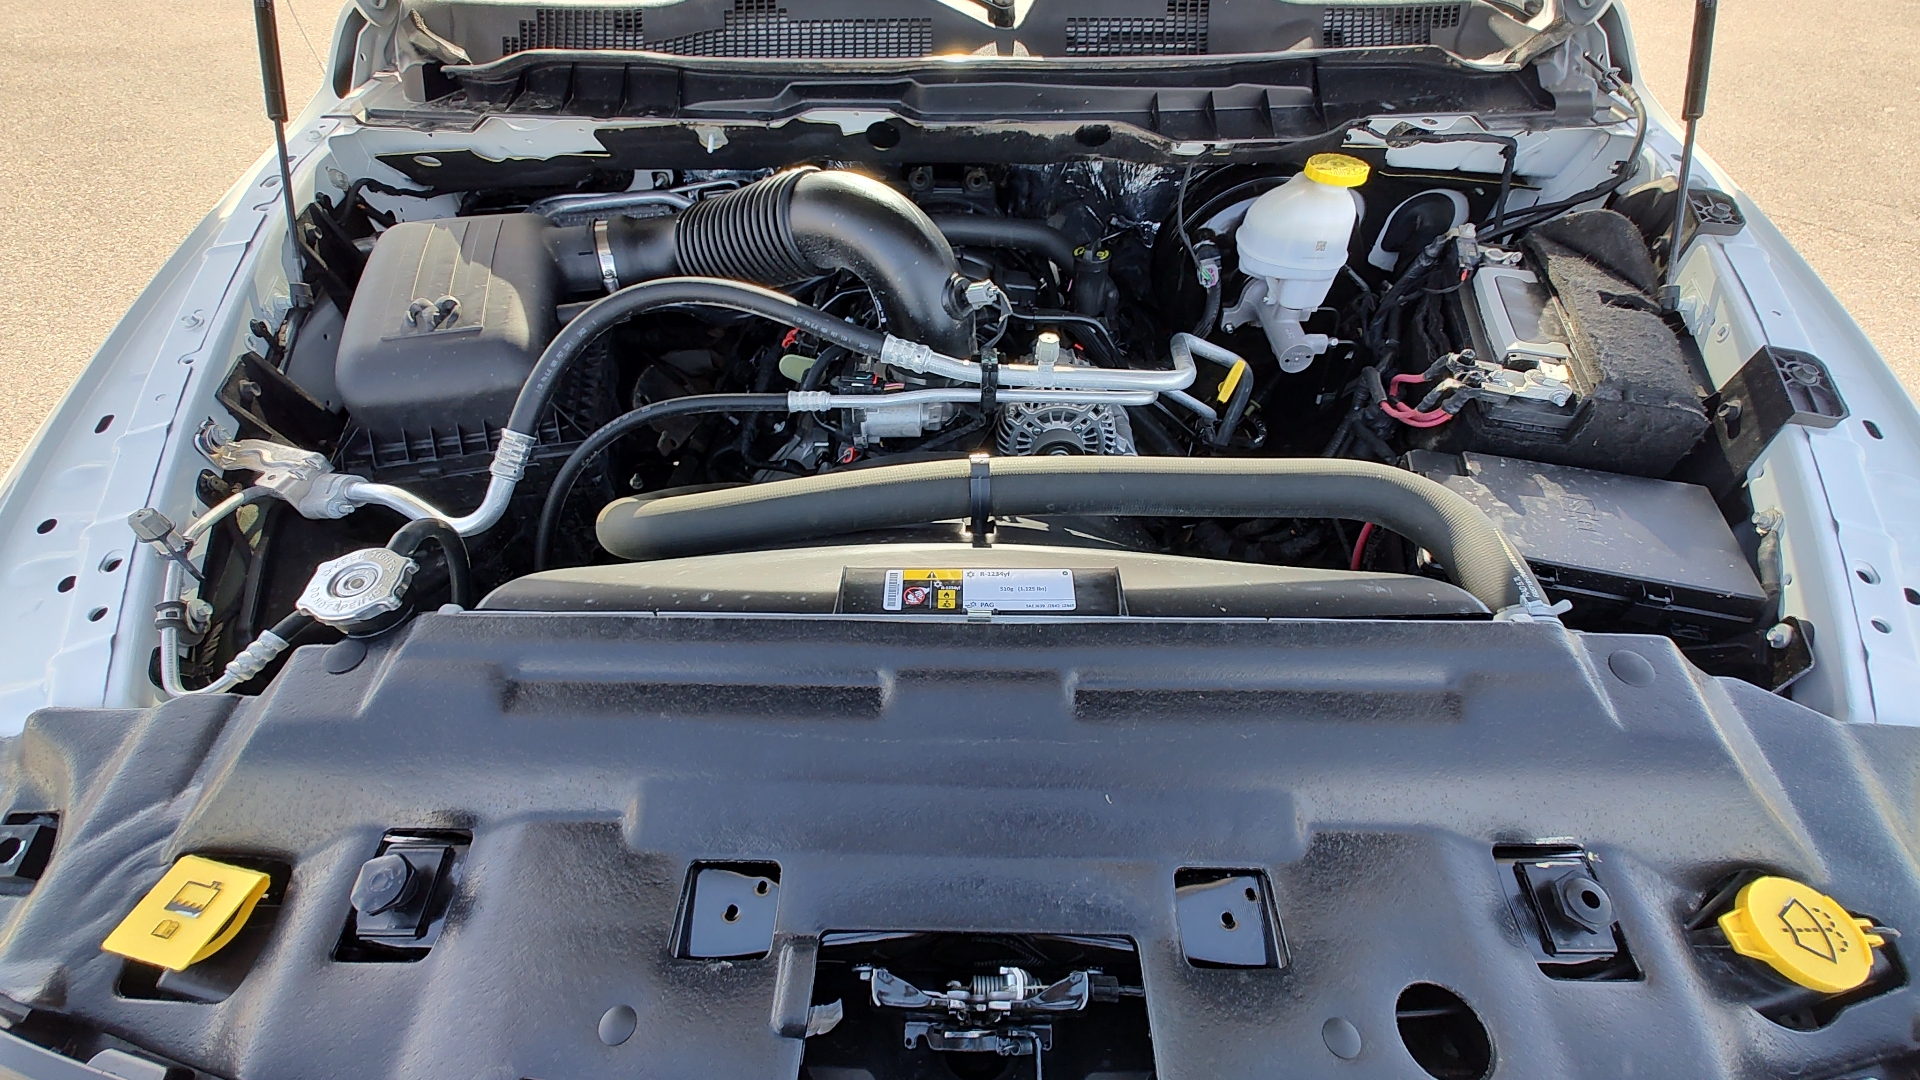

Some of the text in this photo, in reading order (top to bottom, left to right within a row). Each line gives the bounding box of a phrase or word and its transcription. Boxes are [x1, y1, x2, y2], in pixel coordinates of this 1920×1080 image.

[371, 550, 396, 566] TIGHT
[311, 587, 320, 598] DO
[313, 598, 333, 610] NOT
